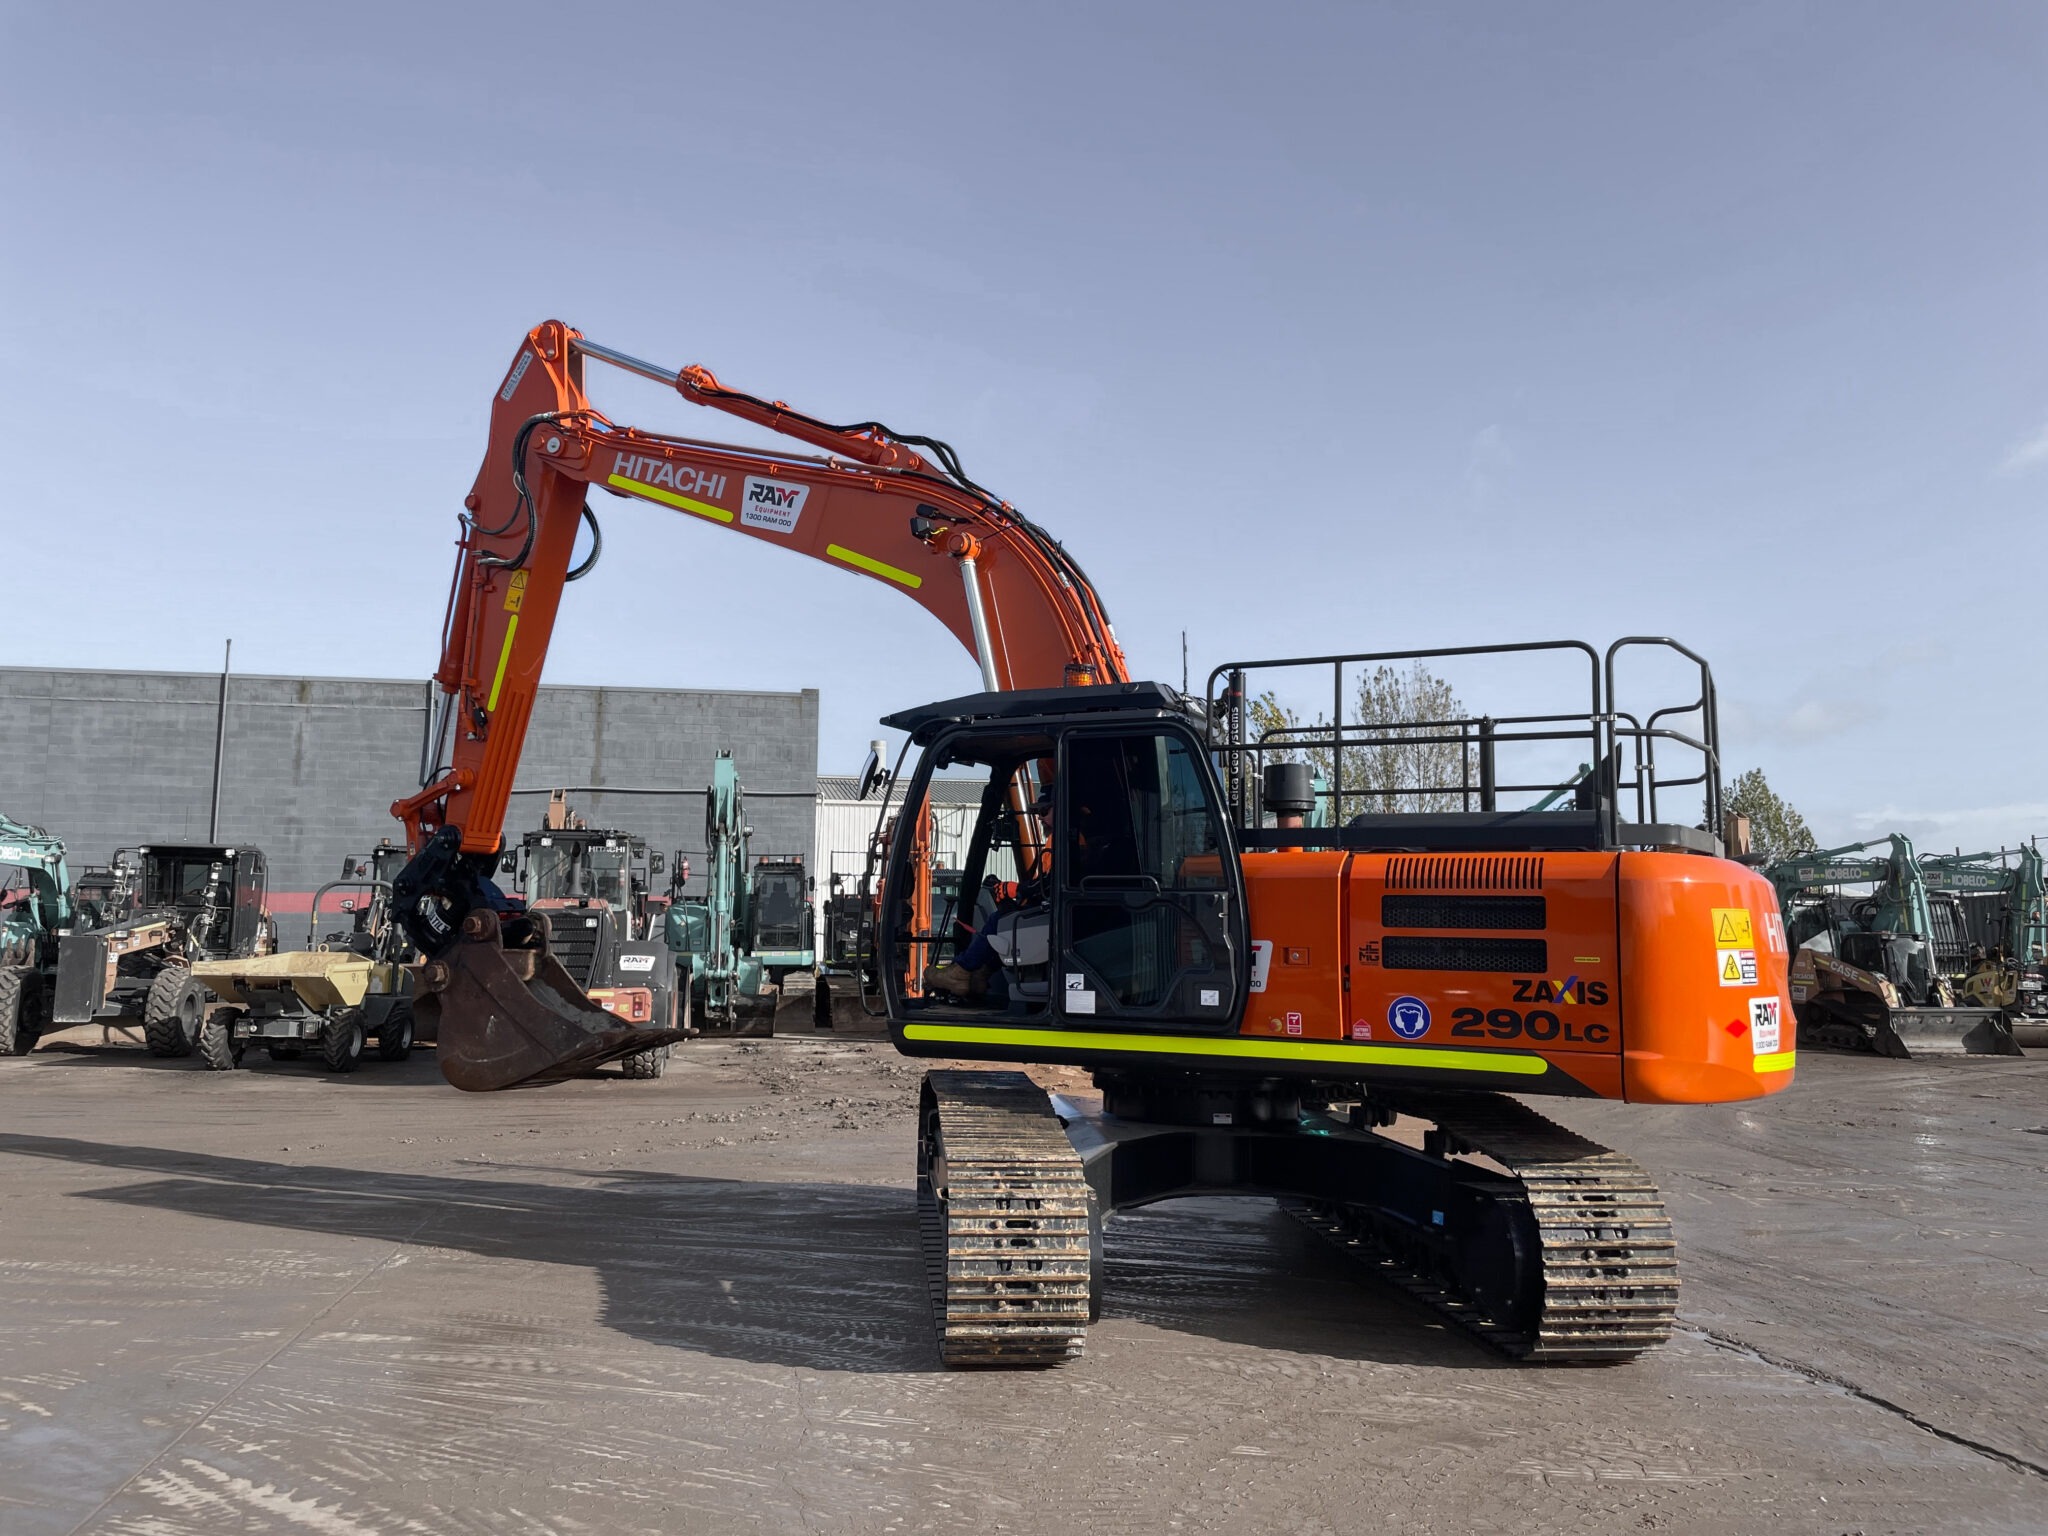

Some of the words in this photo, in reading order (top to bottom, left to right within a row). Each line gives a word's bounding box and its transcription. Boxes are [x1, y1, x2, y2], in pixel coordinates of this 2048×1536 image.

[612, 452, 727, 499] HITACHI
[749, 482, 800, 509] RAM
[745, 512, 762, 522] 1300
[762, 513, 778, 524] RAM
[778, 518, 792, 527] 000
[755, 504, 791, 518] EQUIPMENT
[1231, 778, 1239, 806] Leica
[1824, 867, 1862, 880] KOBELCO
[1951, 874, 1988, 887] KOBELCO
[623, 956, 651, 964] RAM
[1830, 961, 1859, 980] CASE
[1512, 975, 1609, 1006] ZAXIS
[1755, 1002, 1777, 1027] RAM
